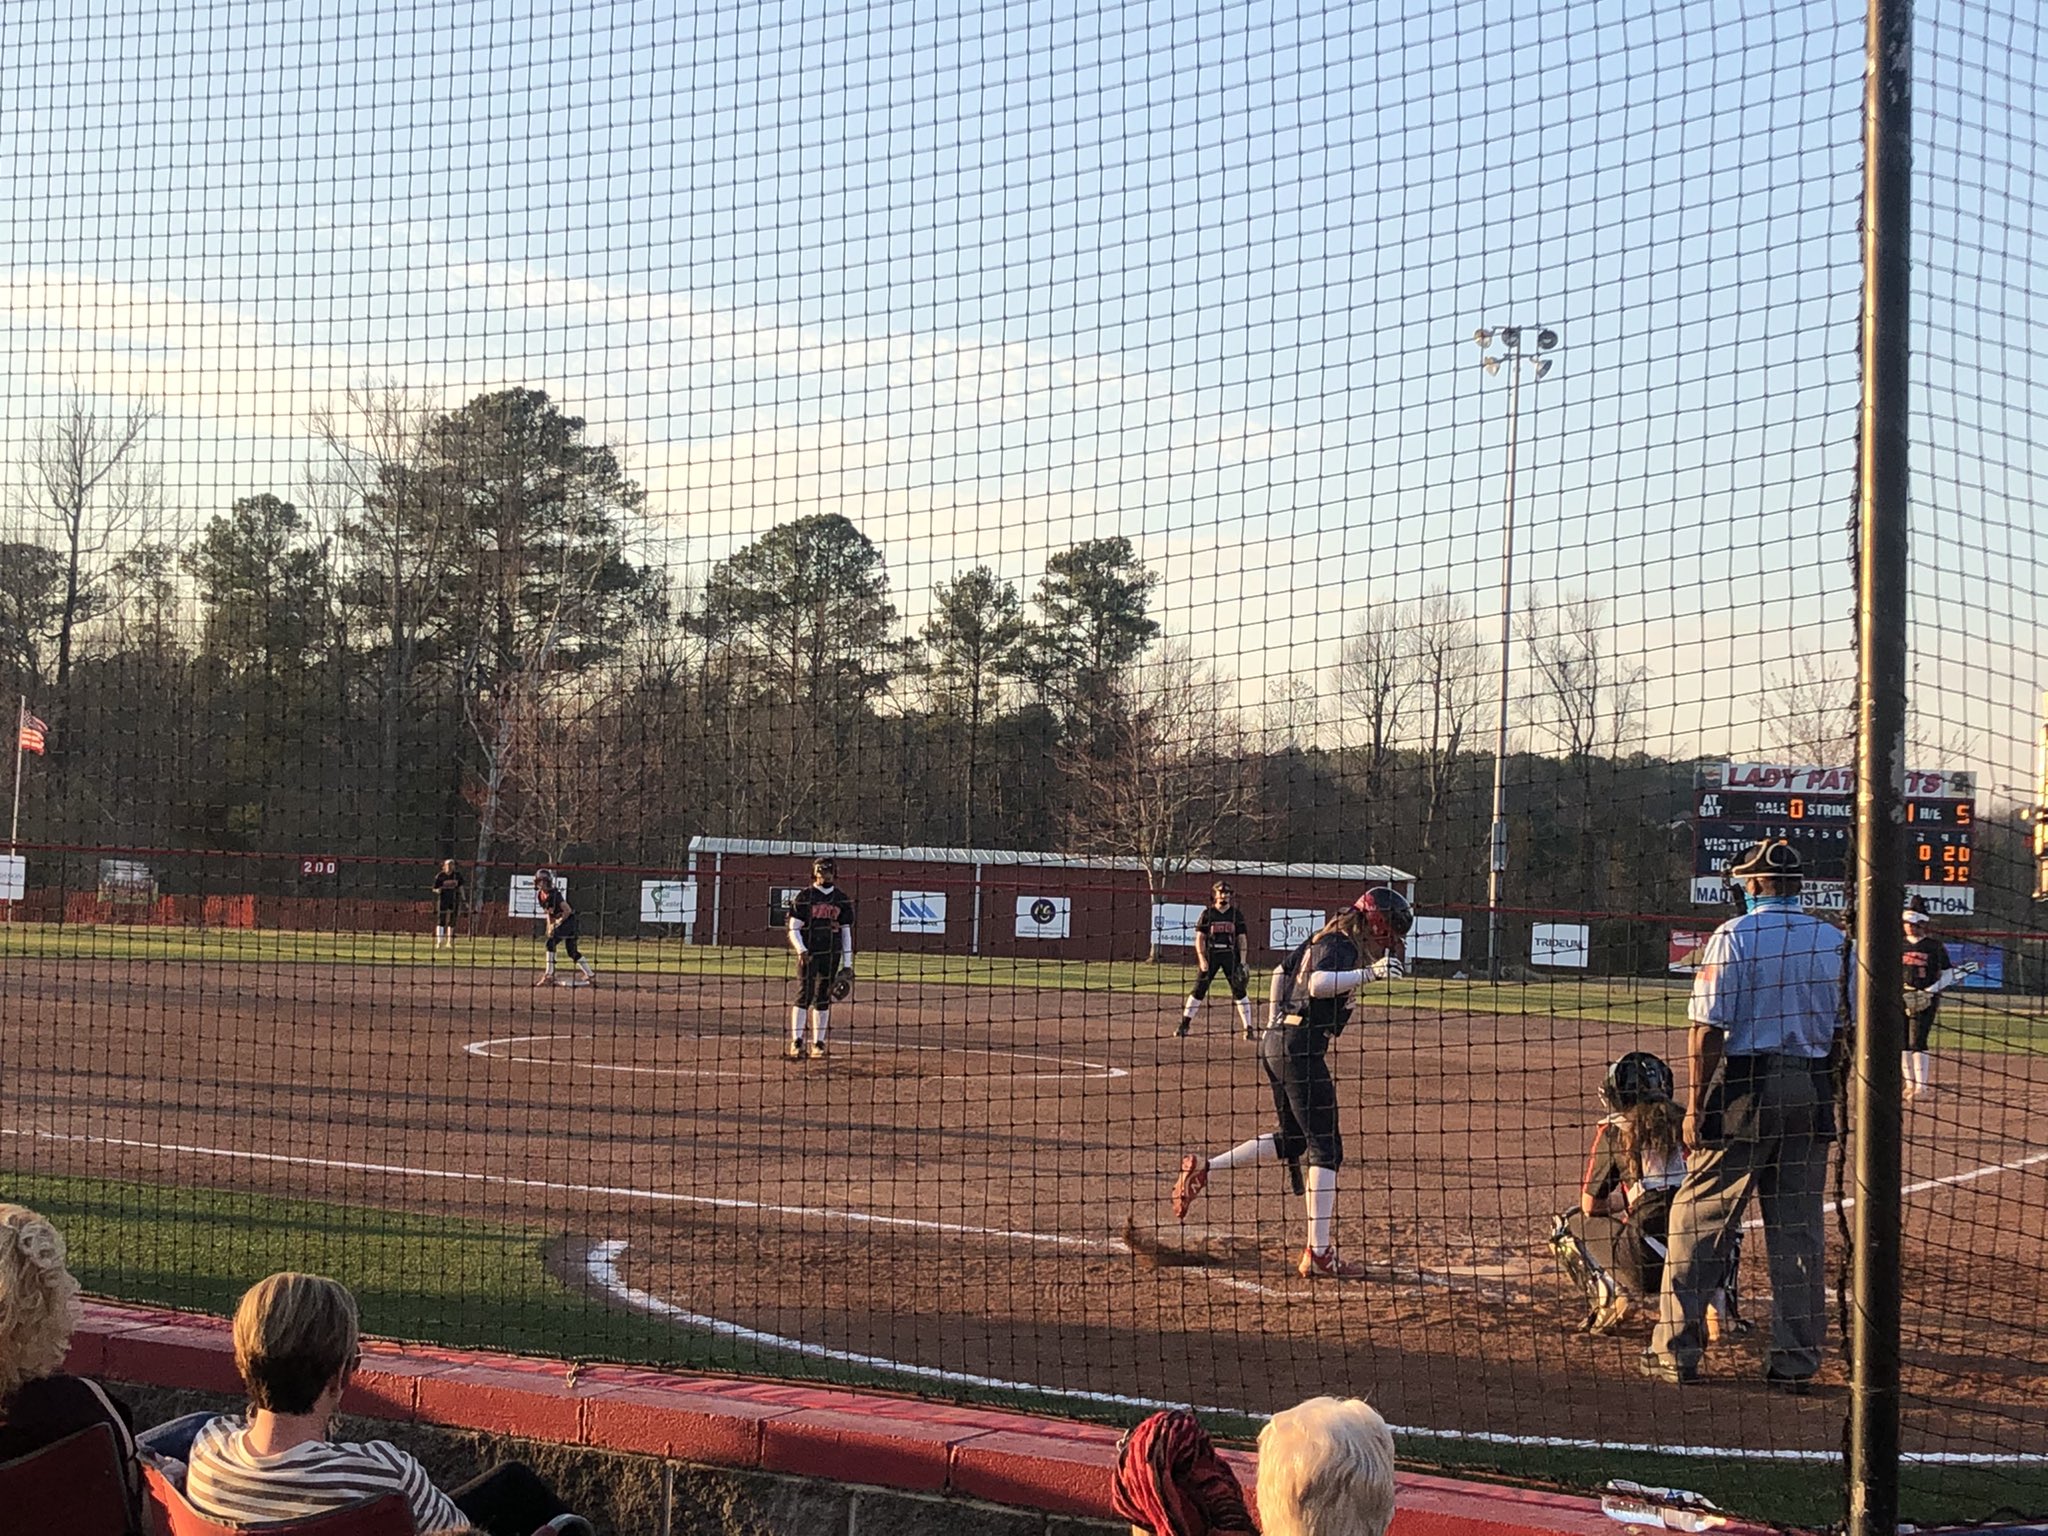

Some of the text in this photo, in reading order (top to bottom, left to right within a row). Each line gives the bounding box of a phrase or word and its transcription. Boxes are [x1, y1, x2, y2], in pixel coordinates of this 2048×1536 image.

[1729, 767, 1800, 789] LADY
[1702, 794, 1719, 806] AT
[1699, 806, 1723, 818] BAT
[1755, 802, 1788, 815] BALL
[1807, 803, 1852, 817] STRIKE
[1778, 827, 1787, 837] 2
[303, 861, 335, 874] 200
